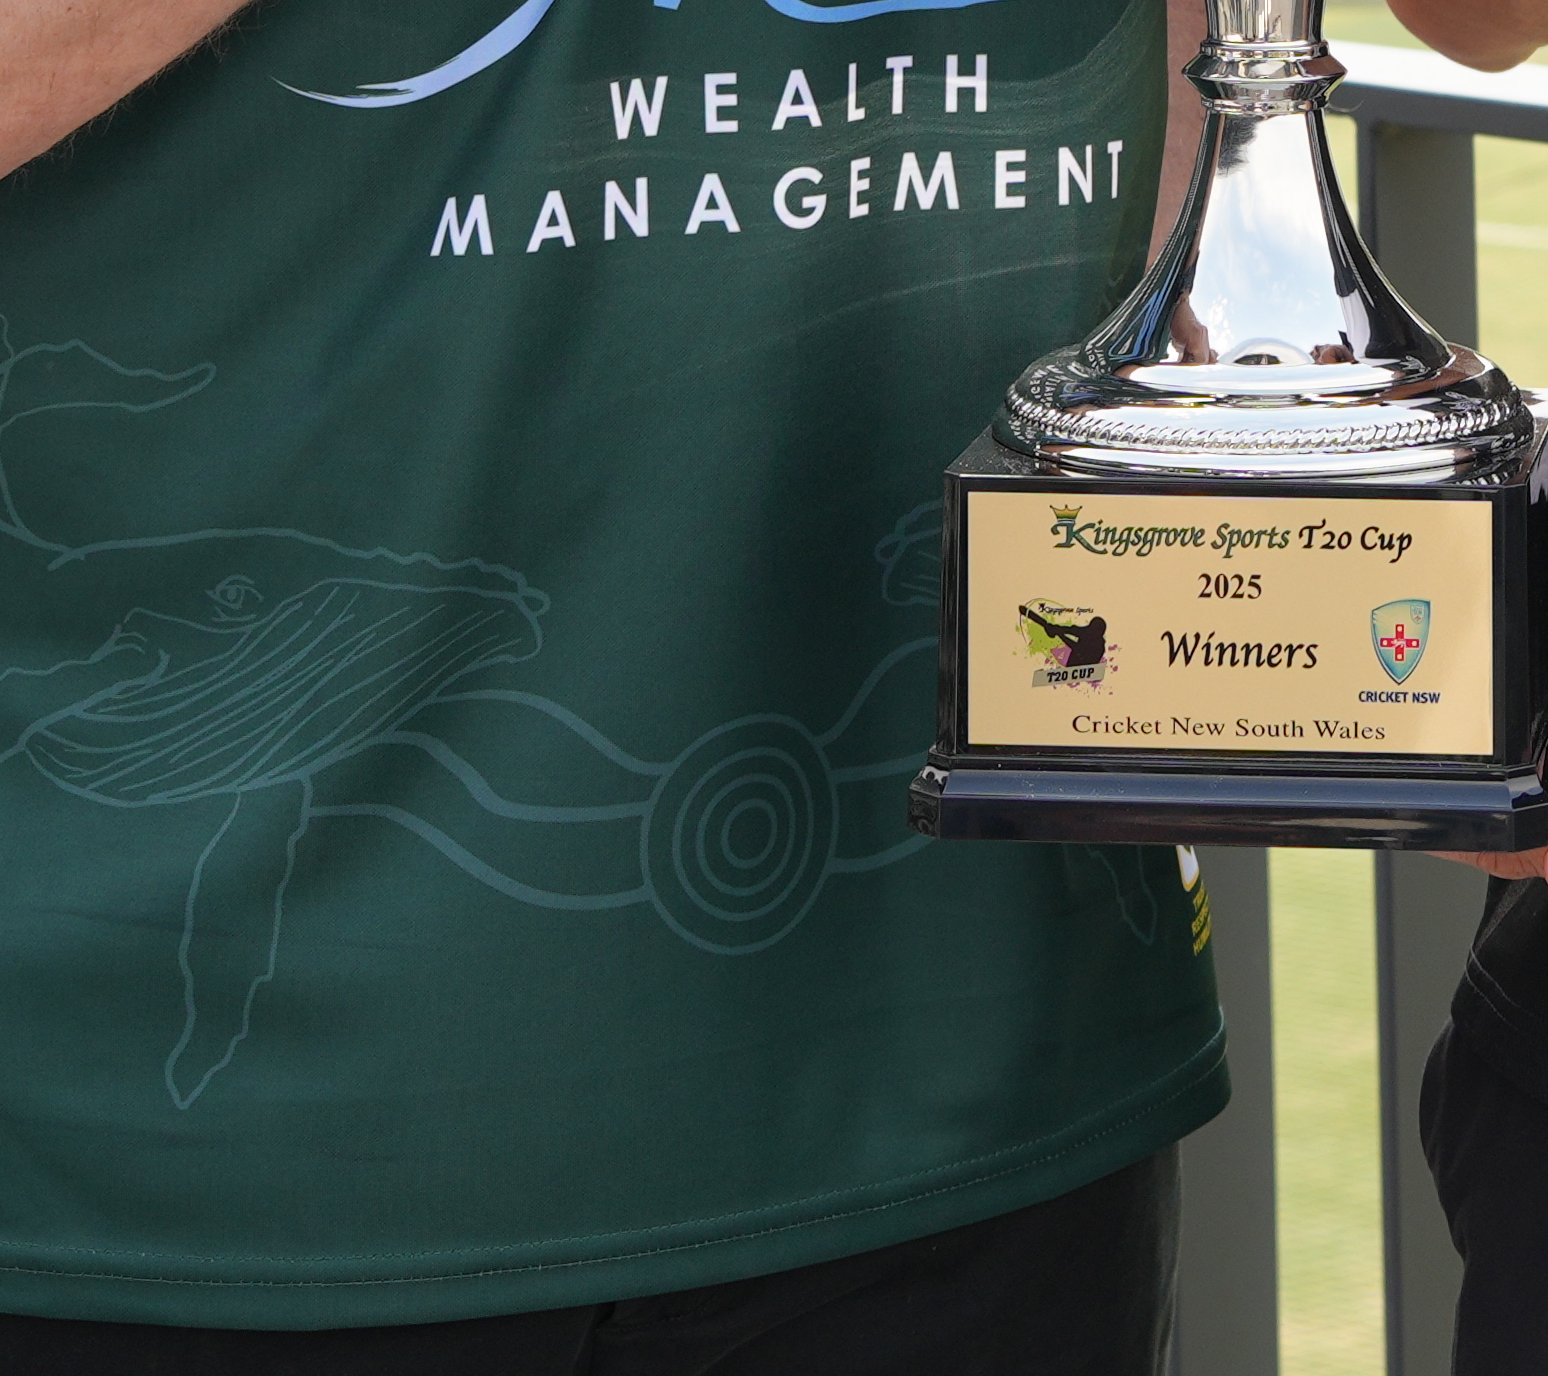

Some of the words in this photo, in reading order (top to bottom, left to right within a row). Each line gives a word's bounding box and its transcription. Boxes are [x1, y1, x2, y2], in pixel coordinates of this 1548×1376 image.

[610, 53, 989, 141] WEALTH
[430, 139, 1124, 258] MANAGEMENT
[1050, 516, 1206, 557] Kingsgrove
[1210, 523, 1291, 559] Sports
[1298, 518, 1352, 549] T20
[1360, 526, 1413, 563] Cup
[1197, 573, 1262, 599] 2025
[1160, 630, 1319, 669] Winners
[1047, 671, 1068, 683] T20
[1072, 668, 1095, 680] CUP
[1358, 691, 1409, 703] CRICKET
[1412, 692, 1441, 704] NSW
[1072, 714, 1161, 735] Cricket
[1171, 716, 1225, 736] New
[1235, 718, 1305, 738] South
[1313, 720, 1386, 740] Wales
